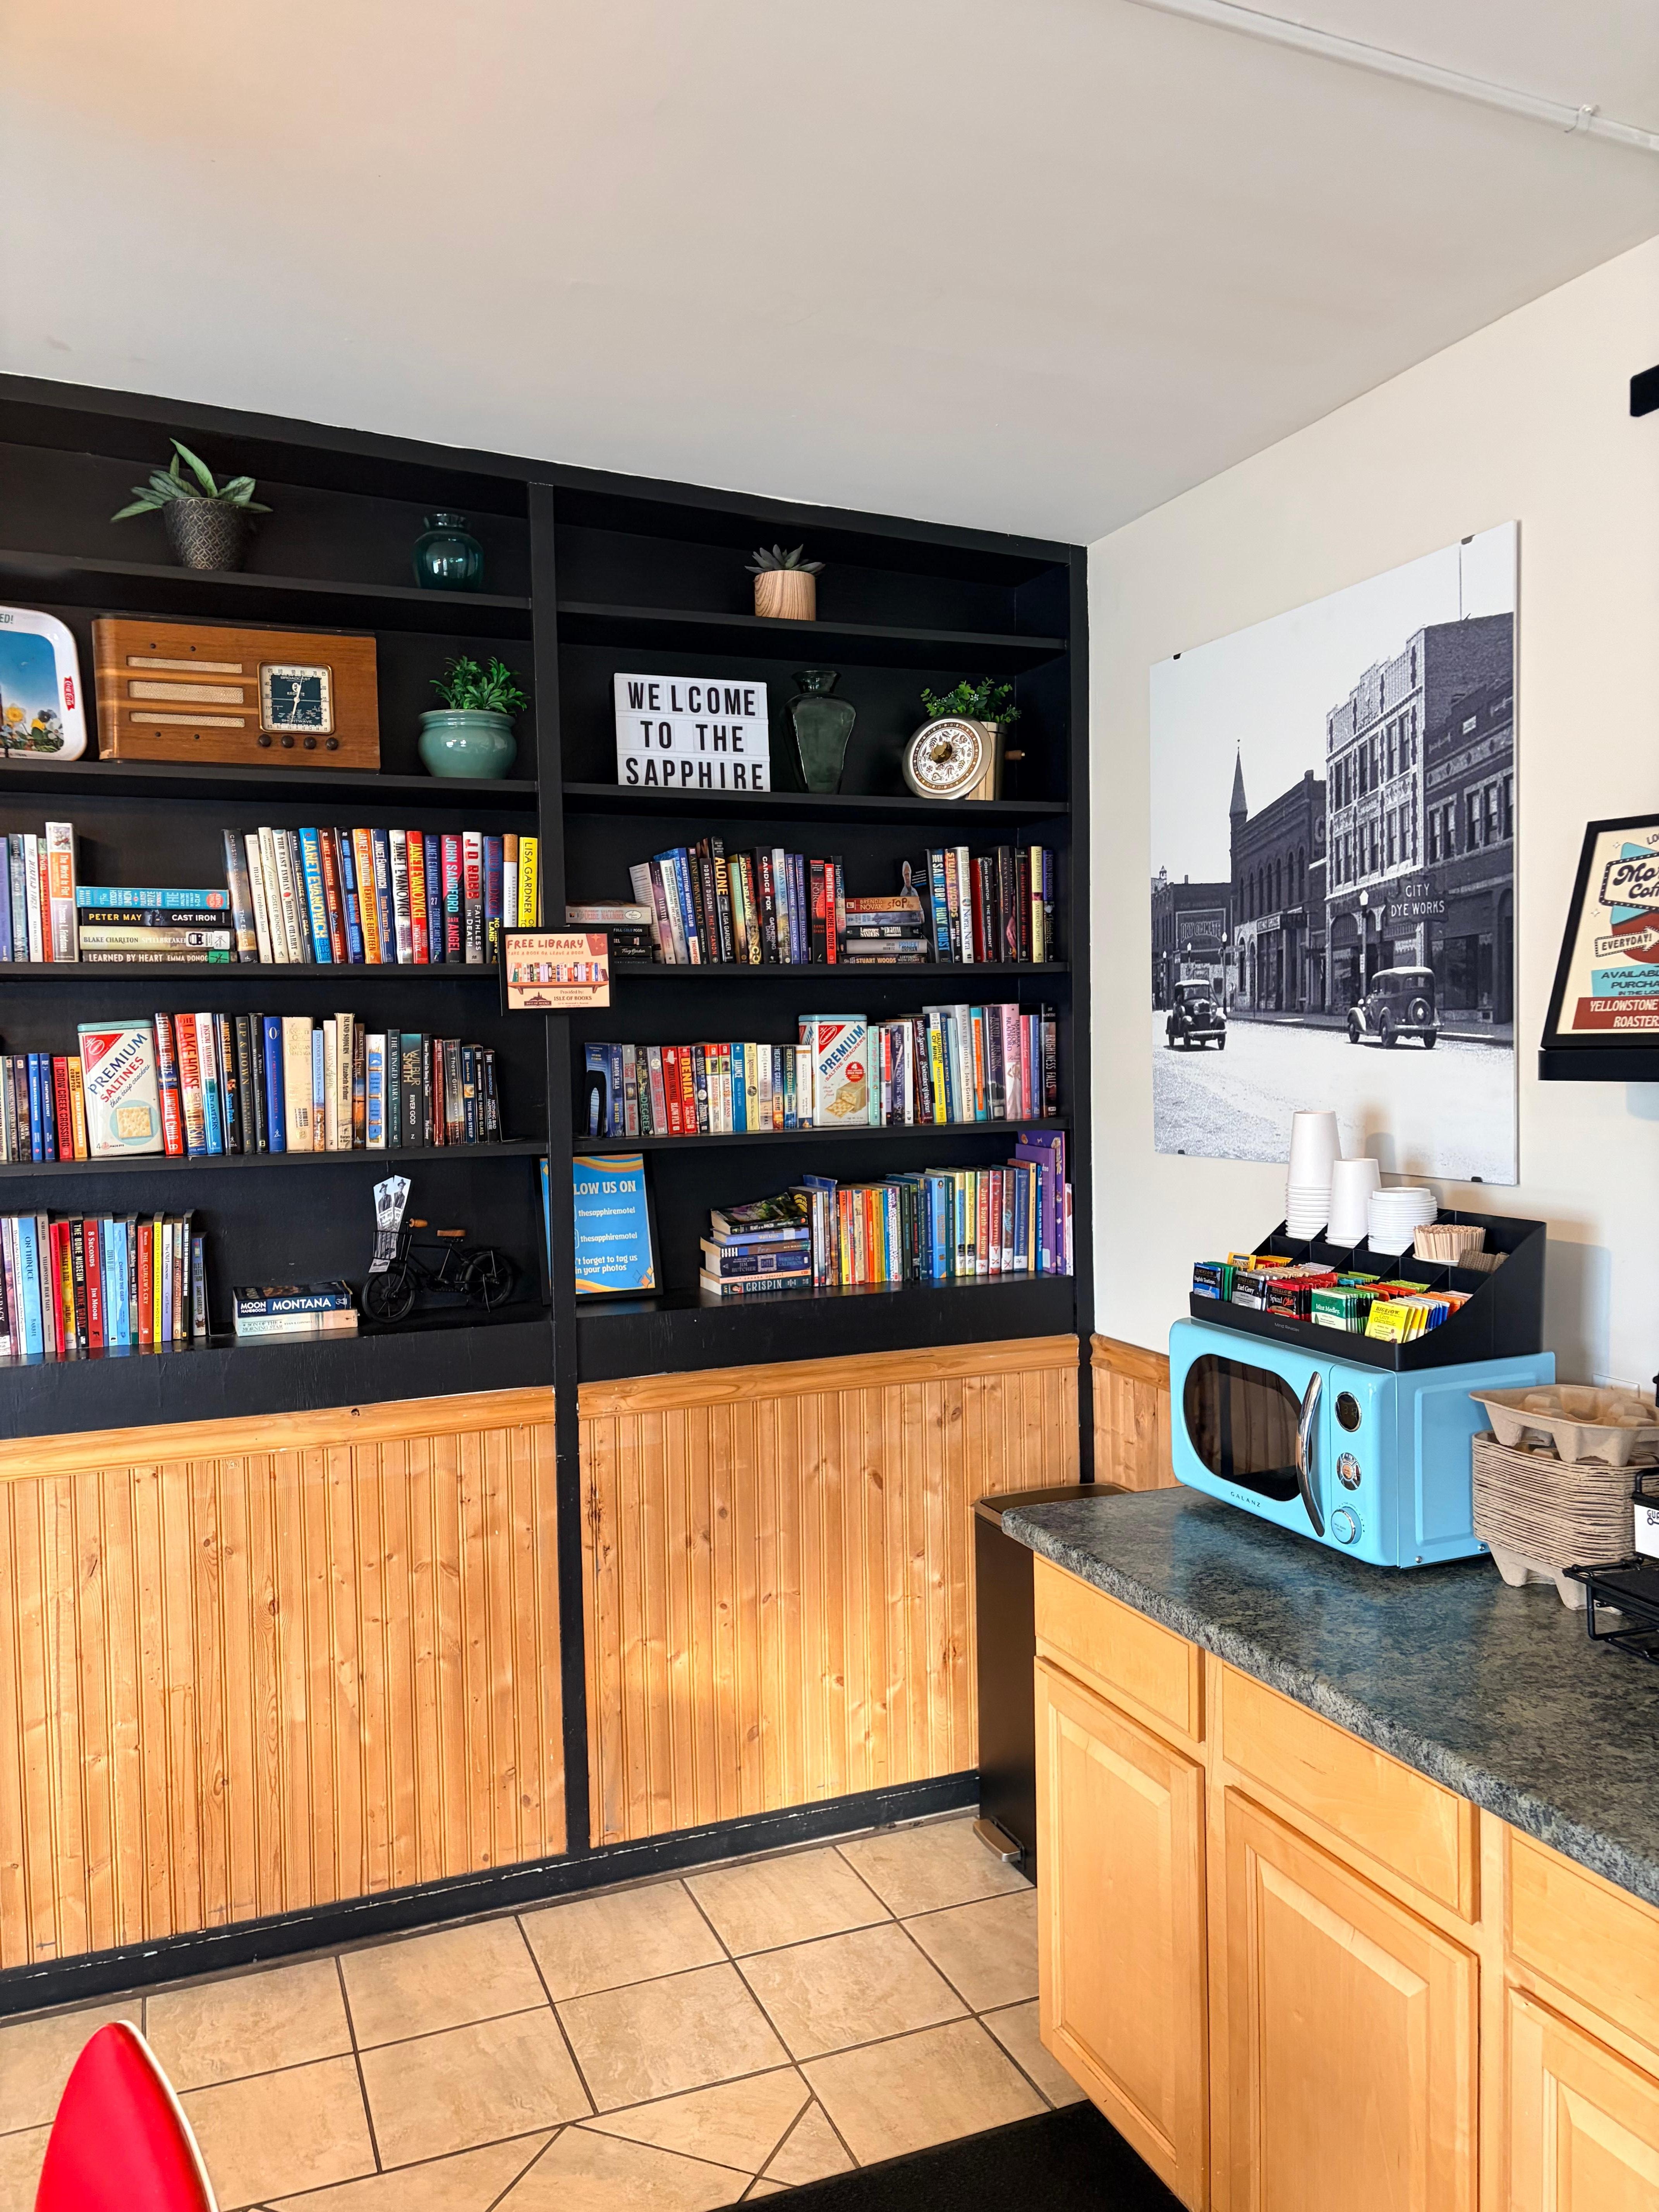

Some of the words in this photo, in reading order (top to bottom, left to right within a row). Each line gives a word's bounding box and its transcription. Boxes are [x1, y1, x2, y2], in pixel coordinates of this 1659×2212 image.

[628, 682, 755, 716] WELCOME
[640, 721, 672, 749] TO
[696, 724, 744, 752] THE
[626, 757, 763, 790] SAPPHIRE
[358, 833, 368, 851] JANET
[445, 837, 457, 862] JOHN
[524, 842, 532, 864] LISA
[60, 855, 69, 864] The
[278, 852, 287, 868] EAST
[303, 838, 320, 875] JANET
[409, 843, 423, 868] JANET
[61, 865, 69, 879] World
[360, 853, 371, 886] EVANOVICH
[680, 857, 690, 891] SUPERSTITION
[714, 857, 728, 895] ALONE
[947, 852, 957, 884] STUART
[1613, 862, 1659, 886] Mo
[61, 886, 69, 896] Flat
[281, 870, 290, 891] INDIAN
[447, 865, 459, 913] SANDFORD
[466, 865, 479, 899] ROBB
[524, 866, 532, 914] GARDNER
[933, 863, 946, 902] SANDFORD
[1405, 883, 1430, 897] CITY
[364, 889, 374, 921] EXPLOSIVE
[411, 870, 426, 918] EVANOVICH
[949, 886, 958, 918] WOODS
[58, 905, 67, 923] Thomas
[284, 901, 294, 924] BRINDA
[308, 876, 328, 938] EVANOVICH
[936, 907, 948, 925] HOLY
[1391, 903, 1409, 917] DYE
[1412, 900, 1445, 915] WORKS
[60, 929, 68, 952] Friedman
[288, 925, 298, 950] CHARRY
[366, 923, 376, 951] EIGHTEEN
[448, 924, 460, 953] ANGEL
[937, 927, 950, 951] GHOST
[1180, 922, 1194, 943] DRY
[1194, 920, 1223, 940] CLIMATE
[1602, 933, 1652, 950] EVERYDAY!
[507, 939, 534, 949] FREE
[538, 939, 584, 948] LIBRARY
[1601, 970, 1659, 979] AVAILABL
[1590, 999, 1658, 1012] YELLOWSTONE
[180, 1023, 196, 1056] LAKE
[238, 1023, 246, 1037] UP
[931, 1036, 937, 1044] OF
[819, 1025, 866, 1075] PREMIUM
[825, 1062, 843, 1082] SALTINE
[843, 1036, 866, 1061] CRACKERS
[1045, 1035, 1056, 1070] BRIGHTNESS
[88, 1033, 148, 1095] PREMIUM
[182, 1058, 200, 1089] HOUSE
[240, 1052, 249, 1085] DOWN
[56, 1069, 66, 1088] CROW
[101, 1056, 144, 1103] SALTINES
[110, 1095, 122, 1108] thin
[122, 1084, 132, 1096] crisp
[133, 1065, 150, 1085] crackers
[680, 1058, 693, 1101] DENIAL
[1046, 1072, 1056, 1088] FALLS
[58, 1090, 68, 1111] CREEK
[59, 1113, 70, 1147] CROSSING
[186, 1103, 205, 1147] PATTERSON
[574, 1182, 599, 1195] LOW
[602, 1182, 617, 1194] US
[620, 1180, 637, 1192] ON
[579, 1206, 635, 1217] thesapphiremotel
[73, 1224, 82, 1237] THE
[580, 1232, 637, 1242] thesapphiremotel
[74, 1238, 82, 1254] BONE
[75, 1256, 84, 1281] MUSEUM
[575, 1266, 581, 1274] in
[583, 1266, 600, 1274] your
[602, 1264, 627, 1273] photos
[583, 1256, 605, 1266] forget
[616, 1255, 627, 1264] tag
[746, 1279, 782, 1292] CRISPIN
[1245, 1286, 1255, 1295] Grey
[240, 1301, 266, 1310] MOON
[272, 1298, 331, 1311] MONTANA
[1231, 1492, 1260, 1507] GALANZ
